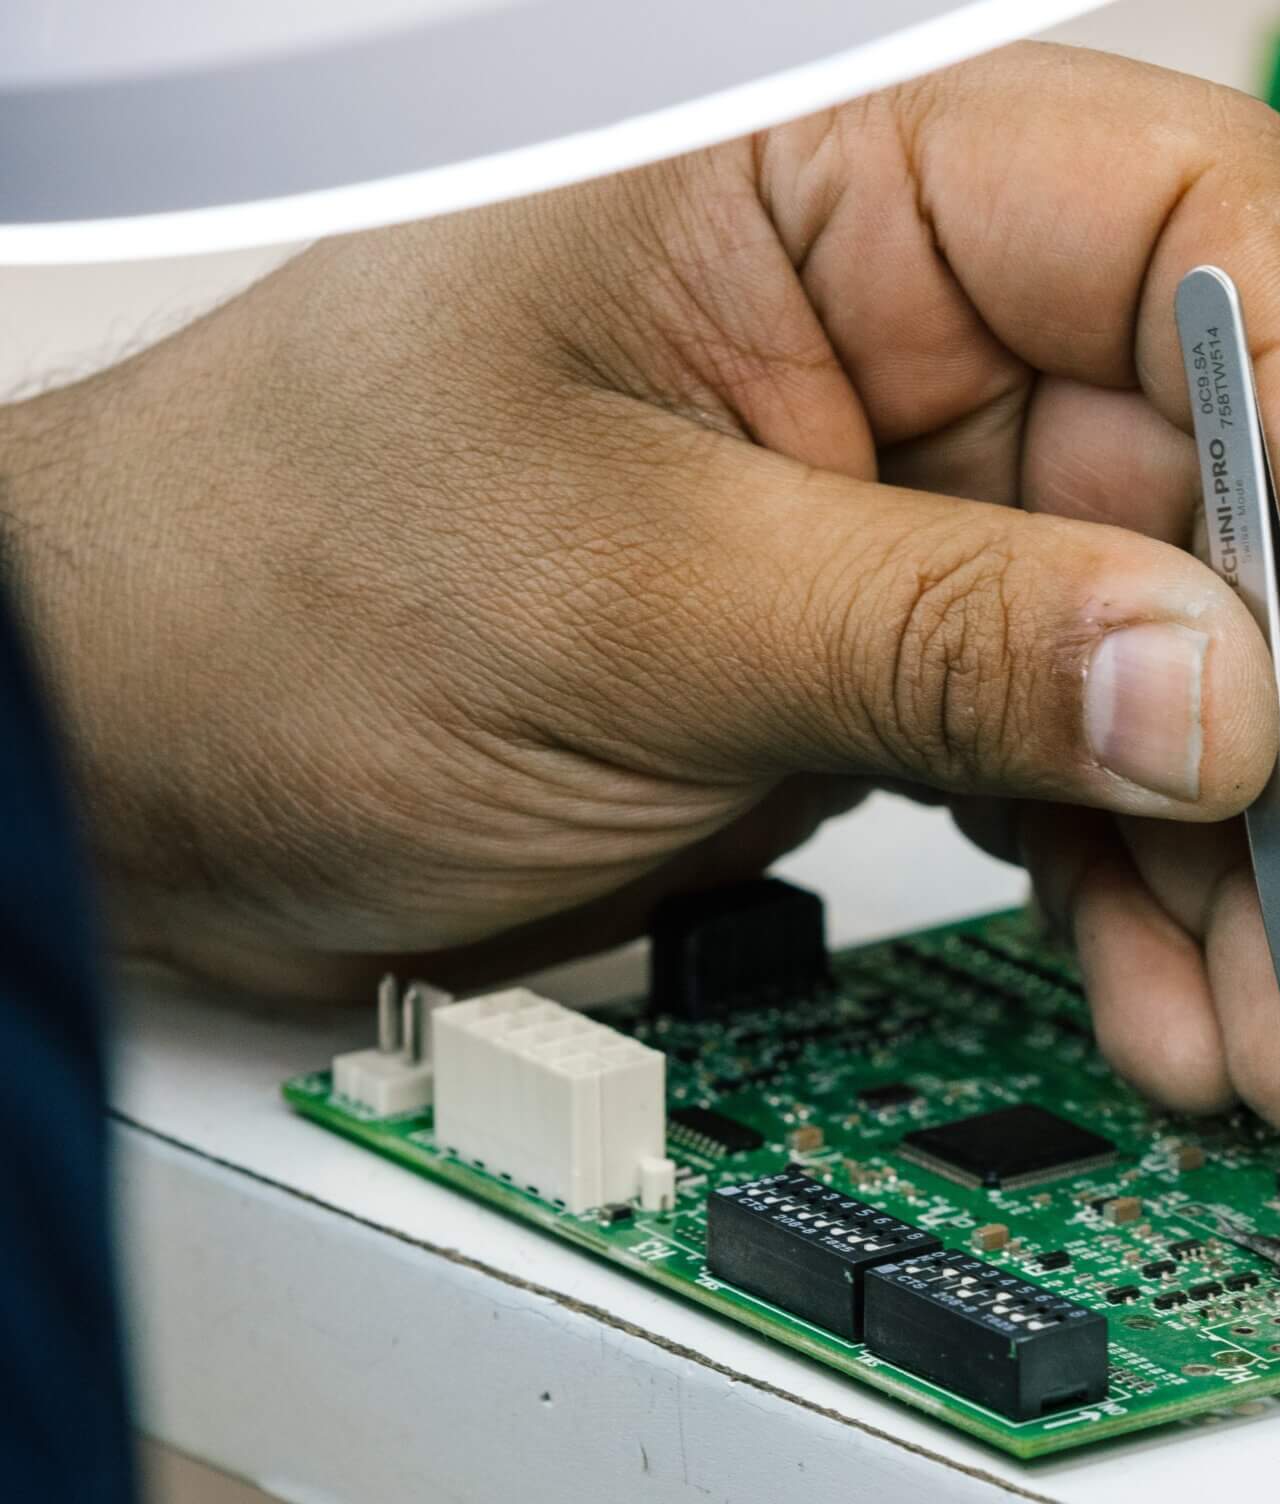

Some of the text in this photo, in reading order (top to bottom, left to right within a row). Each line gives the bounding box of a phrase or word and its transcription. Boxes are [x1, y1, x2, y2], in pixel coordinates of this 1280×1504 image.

[1206, 326, 1234, 429] 758TW514
[1208, 438, 1240, 588] ECHNI-PRO
[738, 1197, 769, 1211] CTS
[803, 1184, 823, 1193] 2
[821, 1193, 840, 1201] 3
[839, 1201, 858, 1209] 4
[855, 1208, 876, 1217] 5
[872, 1217, 894, 1225] 6
[890, 1224, 912, 1232] 7
[906, 1232, 925, 1241] 8
[896, 1274, 929, 1290] CTS
[961, 1261, 982, 1270] 2
[980, 1269, 1000, 1278] 3
[999, 1279, 1018, 1287] 4
[1015, 1286, 1037, 1295] 5
[1034, 1294, 1055, 1302] 6
[1052, 1301, 1073, 1310] 7
